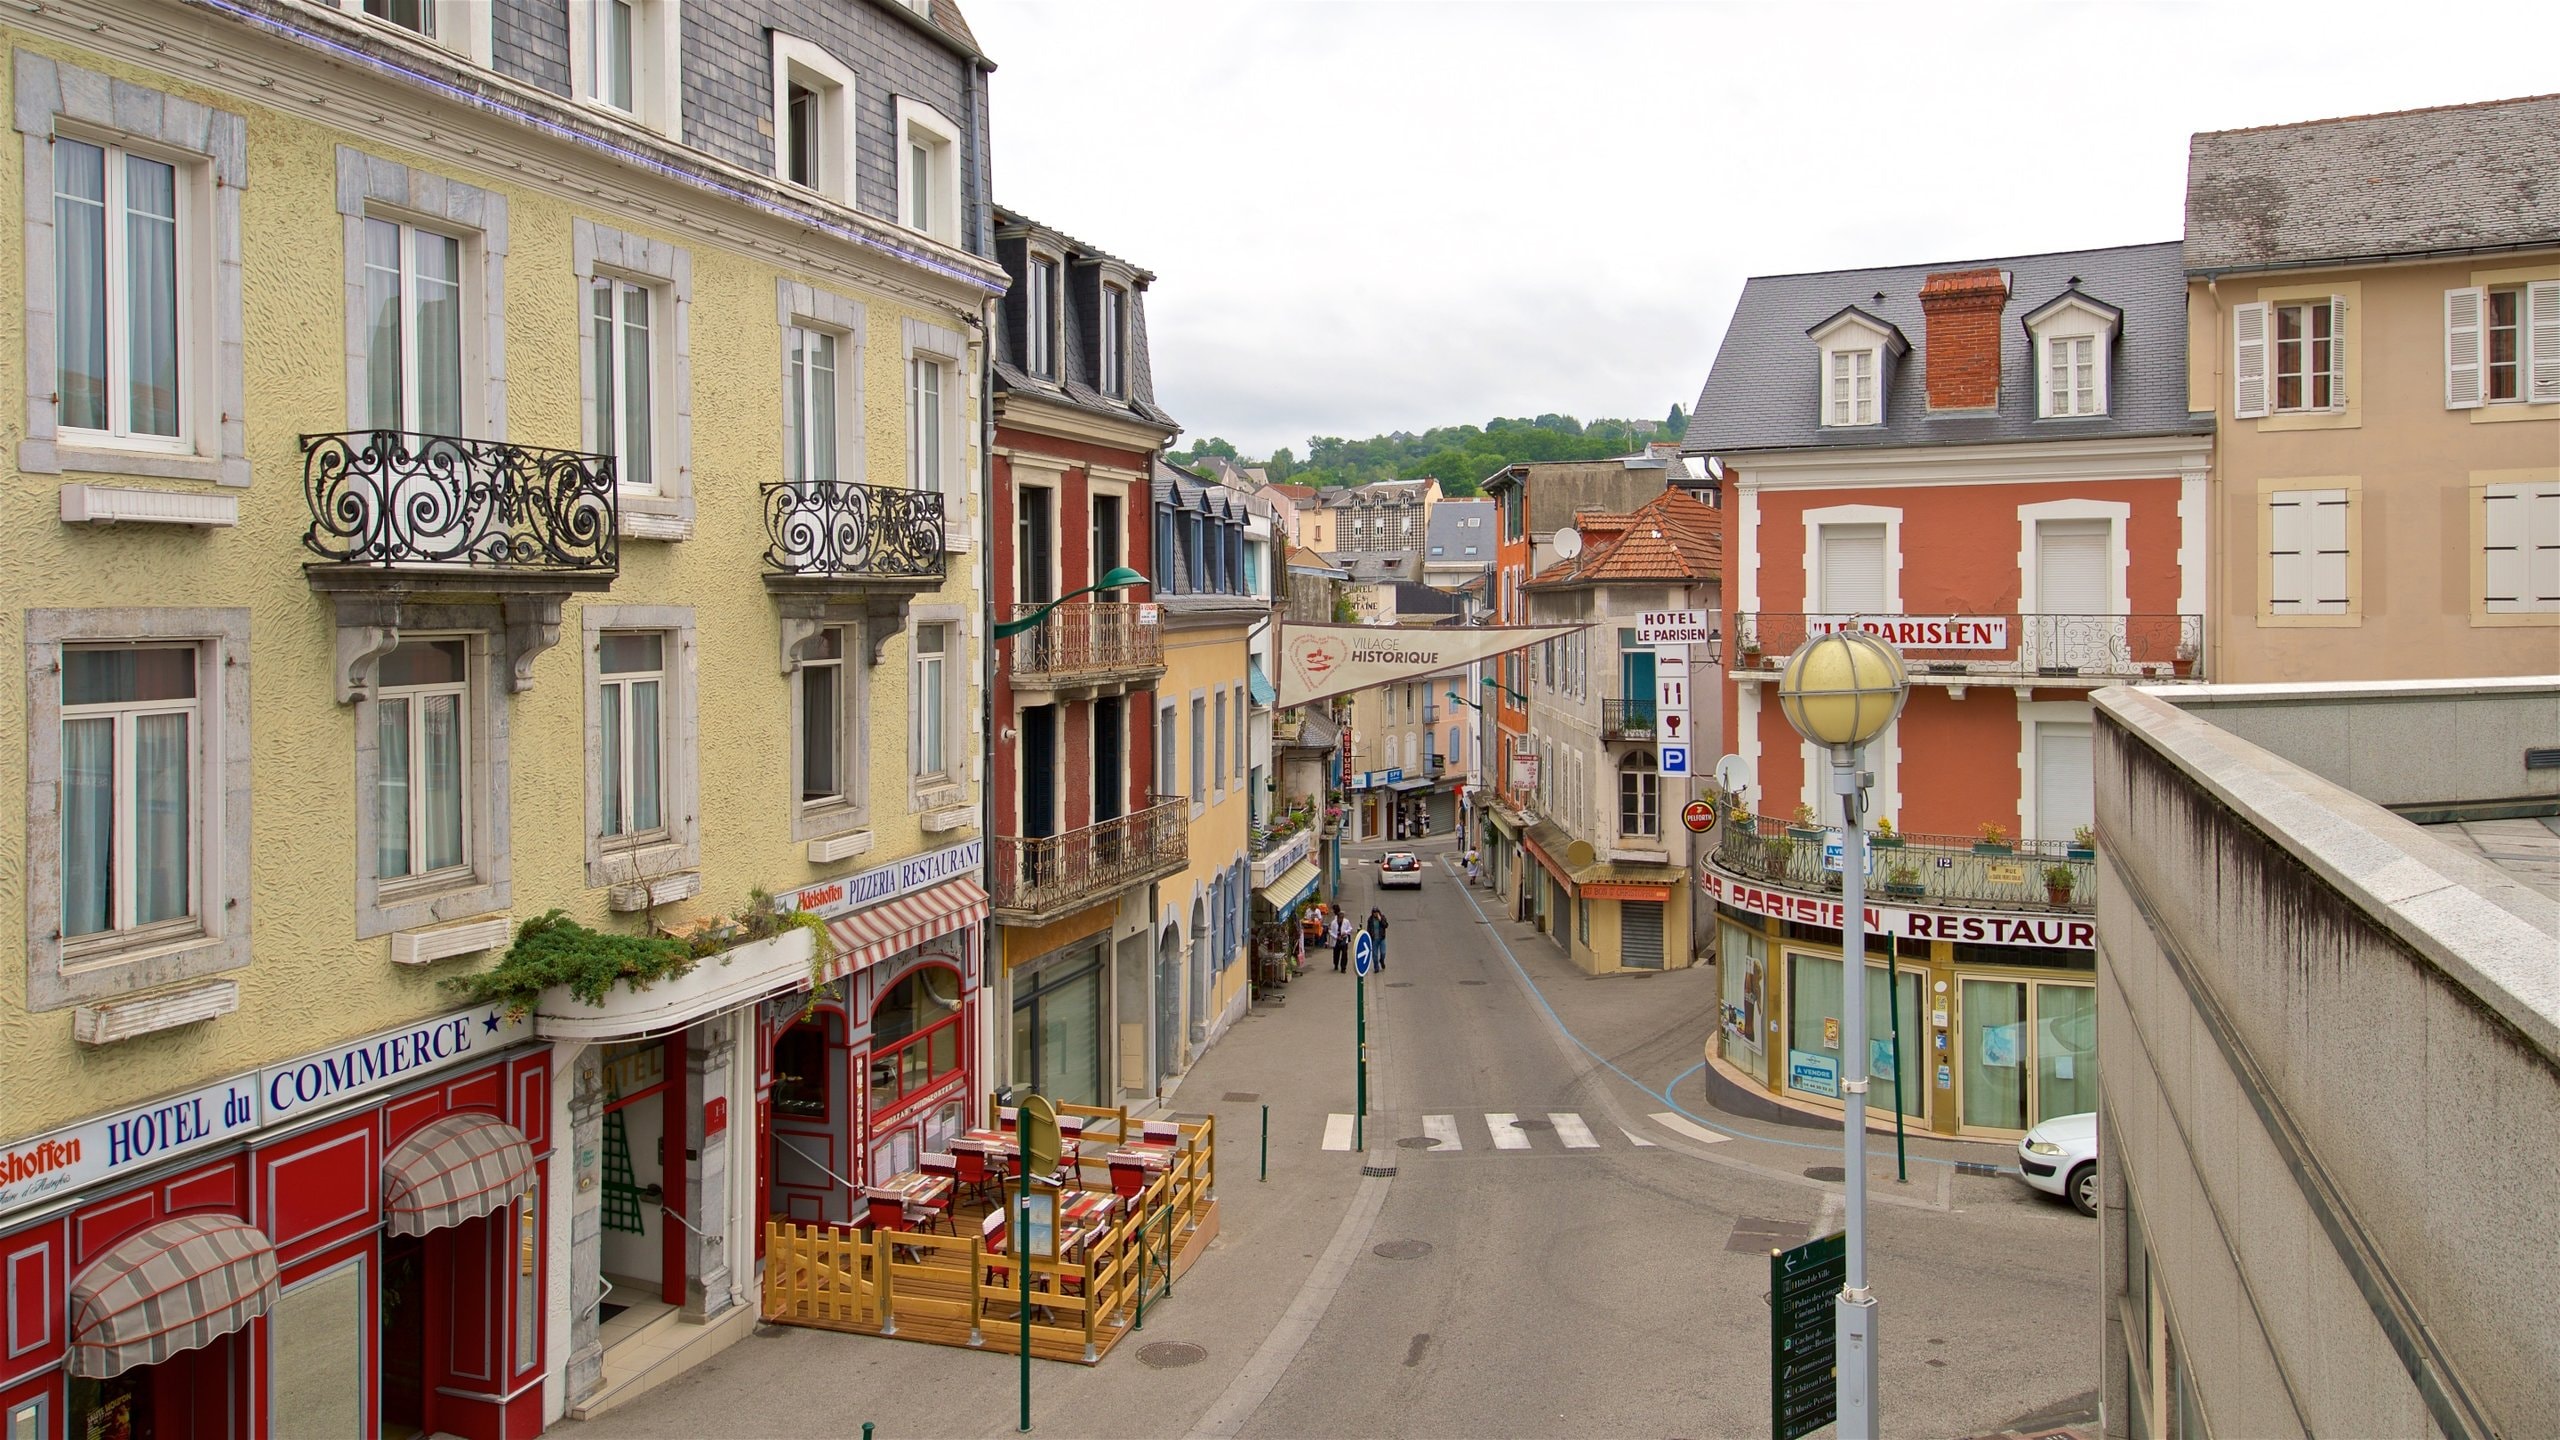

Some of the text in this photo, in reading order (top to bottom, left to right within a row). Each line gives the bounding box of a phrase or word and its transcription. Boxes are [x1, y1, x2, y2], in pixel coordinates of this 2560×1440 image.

[1644, 612, 1697, 625] HOTEL
[1637, 627, 1706, 642] LE PARISIEN
[1863, 623, 2003, 644] PARISIEN"
[1352, 637, 1400, 651] VILLAGE
[1351, 650, 1439, 664] HISTORIQUE
[1344, 729, 1352, 786] RESTAURANT
[1665, 751, 1683, 769] P
[1686, 812, 1713, 823] PELFORTH
[1938, 857, 1951, 868] 12
[849, 868, 896, 906] PIZZERIA
[902, 841, 982, 889] RESTAURANT
[1701, 870, 2095, 948] BAR PARISIEN RESTAUR
[1802, 1068, 1831, 1078] VENDRE
[107, 1016, 472, 1168] HOTEL du COMMERCE
[716, 1102, 726, 1118] H
[1794, 1268, 1831, 1289] Hôtel de Ville
[1794, 1296, 1812, 1309] Palais
[1816, 1303, 1825, 1312] Le
[1795, 1328, 1822, 1346] Cachot de
[1794, 1353, 1833, 1375] Commissariat
[1795, 1373, 1831, 1394] Château Fort
[1795, 1401, 1812, 1414] Musée
[1795, 1426, 1806, 1434] Les
